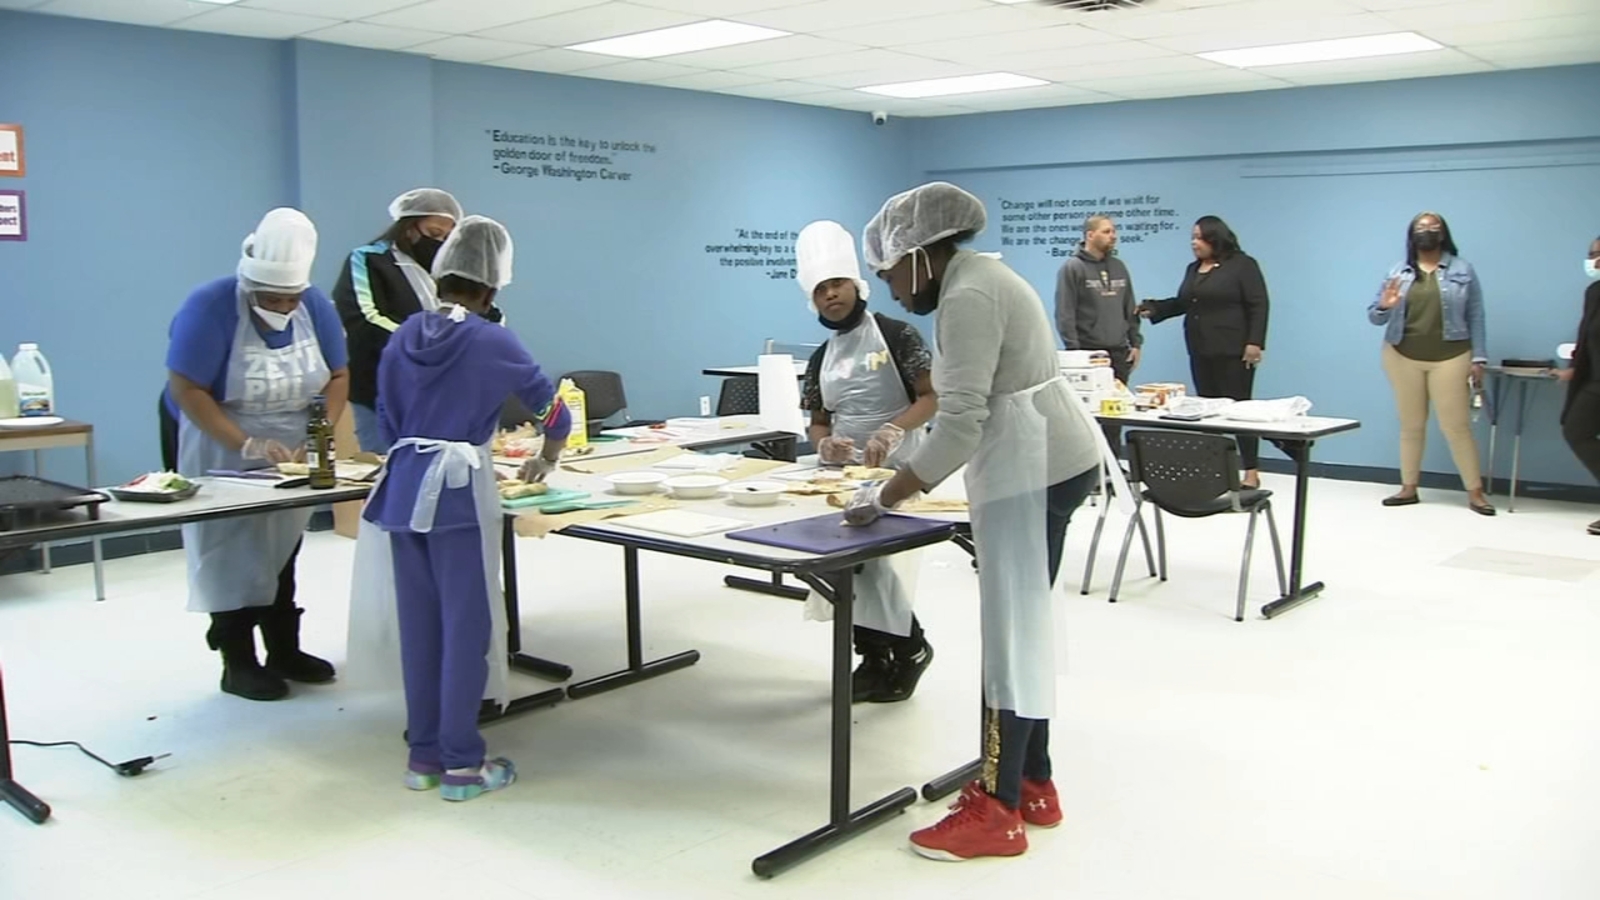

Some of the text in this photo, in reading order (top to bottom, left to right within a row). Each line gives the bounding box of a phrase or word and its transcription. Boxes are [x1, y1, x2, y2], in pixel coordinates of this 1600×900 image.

[560, 135, 576, 147] the
[578, 137, 596, 152] key
[599, 139, 609, 149] to
[611, 141, 640, 151] unlock
[643, 143, 656, 153] the
[493, 148, 526, 160] golden
[528, 150, 552, 161] door
[555, 151, 566, 161] of
[541, 164, 597, 181] Washington
[600, 168, 632, 181] Carver
[1038, 199, 1053, 208] will
[1055, 199, 1070, 208] not
[1072, 199, 1097, 207] come
[1124, 196, 1144, 205] wait
[1145, 195, 1160, 205] for
[1002, 214, 1026, 222] some
[1028, 212, 1051, 221] other
[1053, 211, 1085, 222] person
[1125, 207, 1152, 217] other
[1016, 226, 1031, 234] are
[1033, 224, 1047, 233] the
[1049, 224, 1070, 233] ones
[1125, 222, 1159, 234] waiting
[751, 230, 764, 240] the
[765, 230, 779, 240] end
[1016, 238, 1031, 246] are
[1033, 236, 1047, 246] the
[774, 244, 782, 253] to
[719, 257, 733, 267] the
